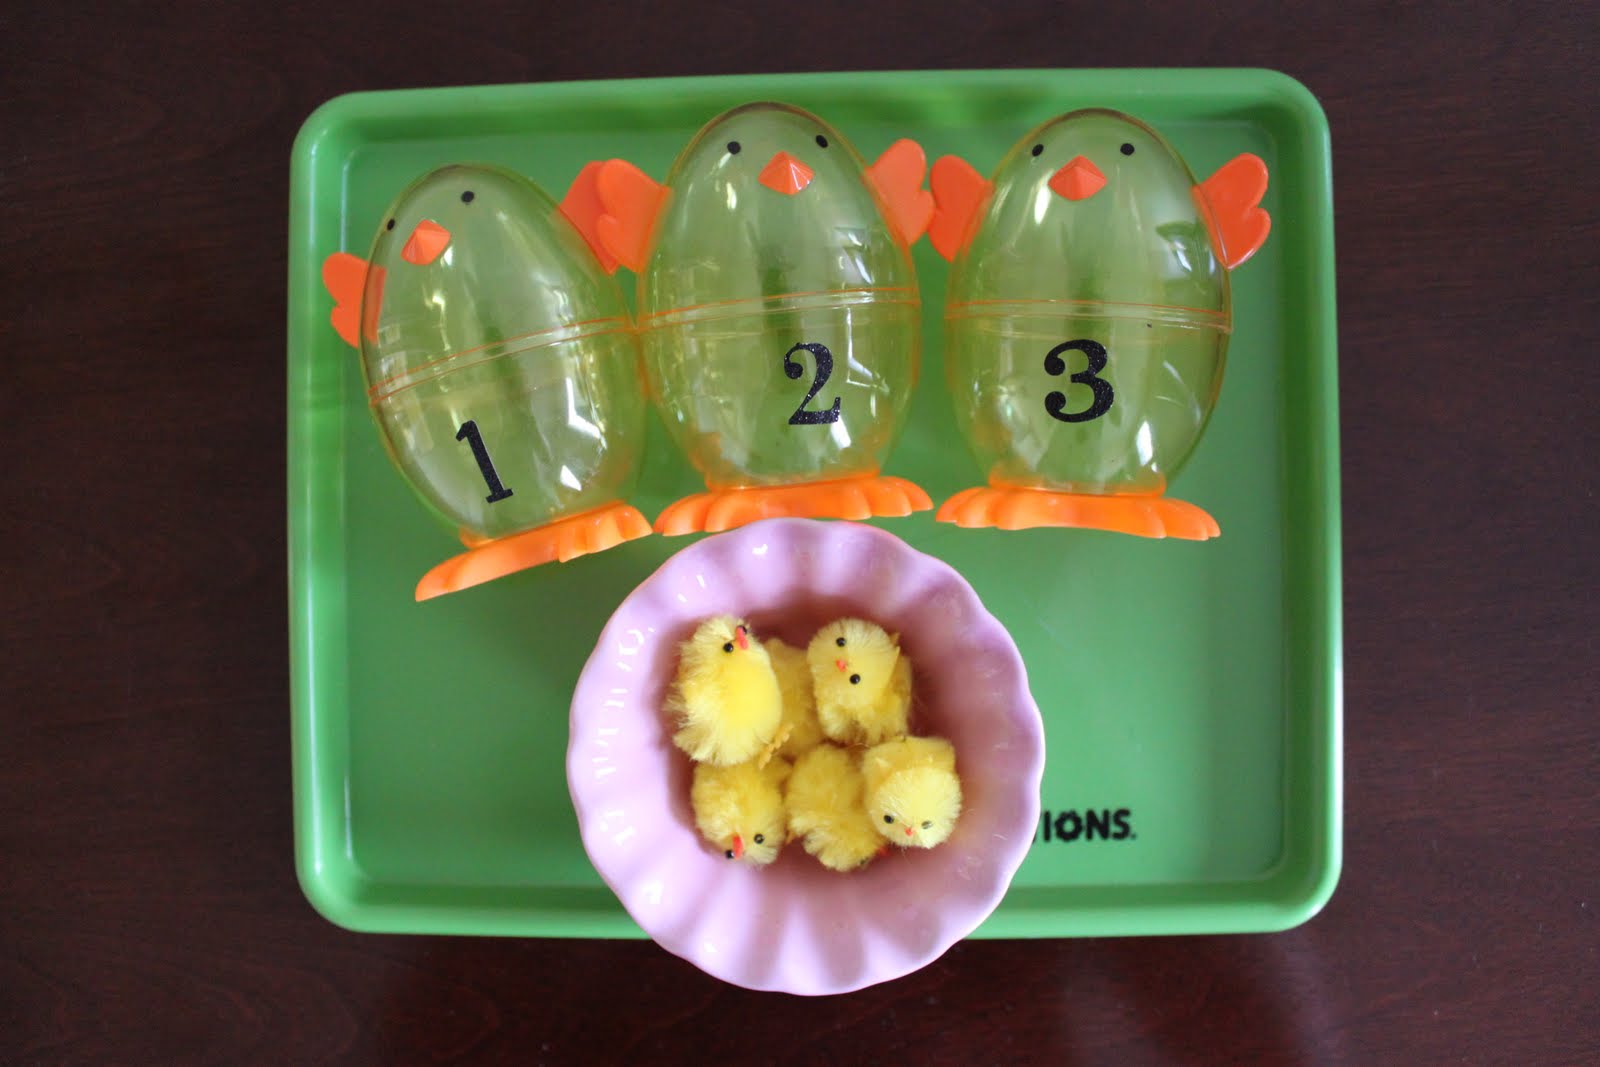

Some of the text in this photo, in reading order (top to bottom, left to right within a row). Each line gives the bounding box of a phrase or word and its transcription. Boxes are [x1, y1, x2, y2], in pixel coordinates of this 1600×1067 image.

[783, 342, 842, 426] 2
[1043, 338, 1114, 423] 3
[455, 420, 513, 504] 1
